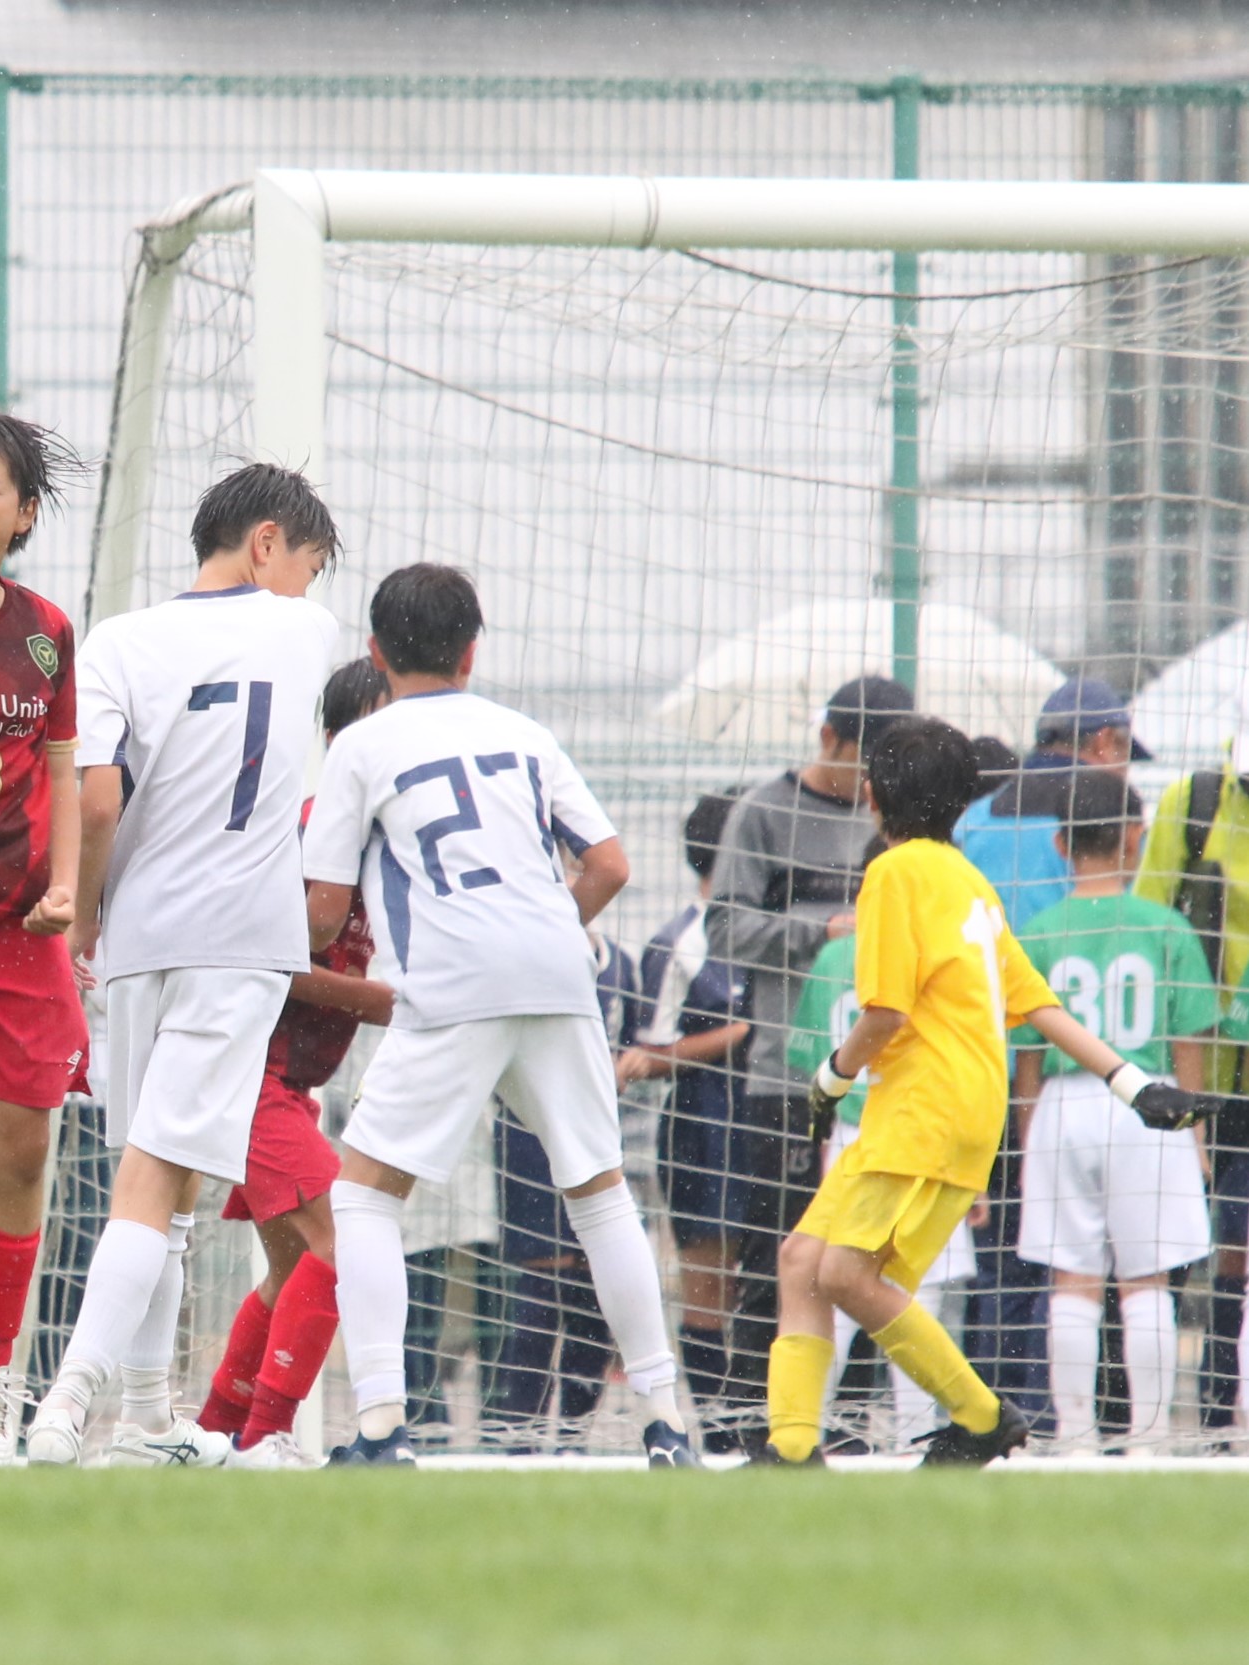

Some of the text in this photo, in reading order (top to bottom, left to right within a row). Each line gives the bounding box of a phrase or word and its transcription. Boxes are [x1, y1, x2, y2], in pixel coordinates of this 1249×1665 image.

[0, 694, 48, 719] Unit
[188, 681, 272, 831] 7
[394, 751, 563, 897] 27
[1049, 953, 1155, 1050] 30
